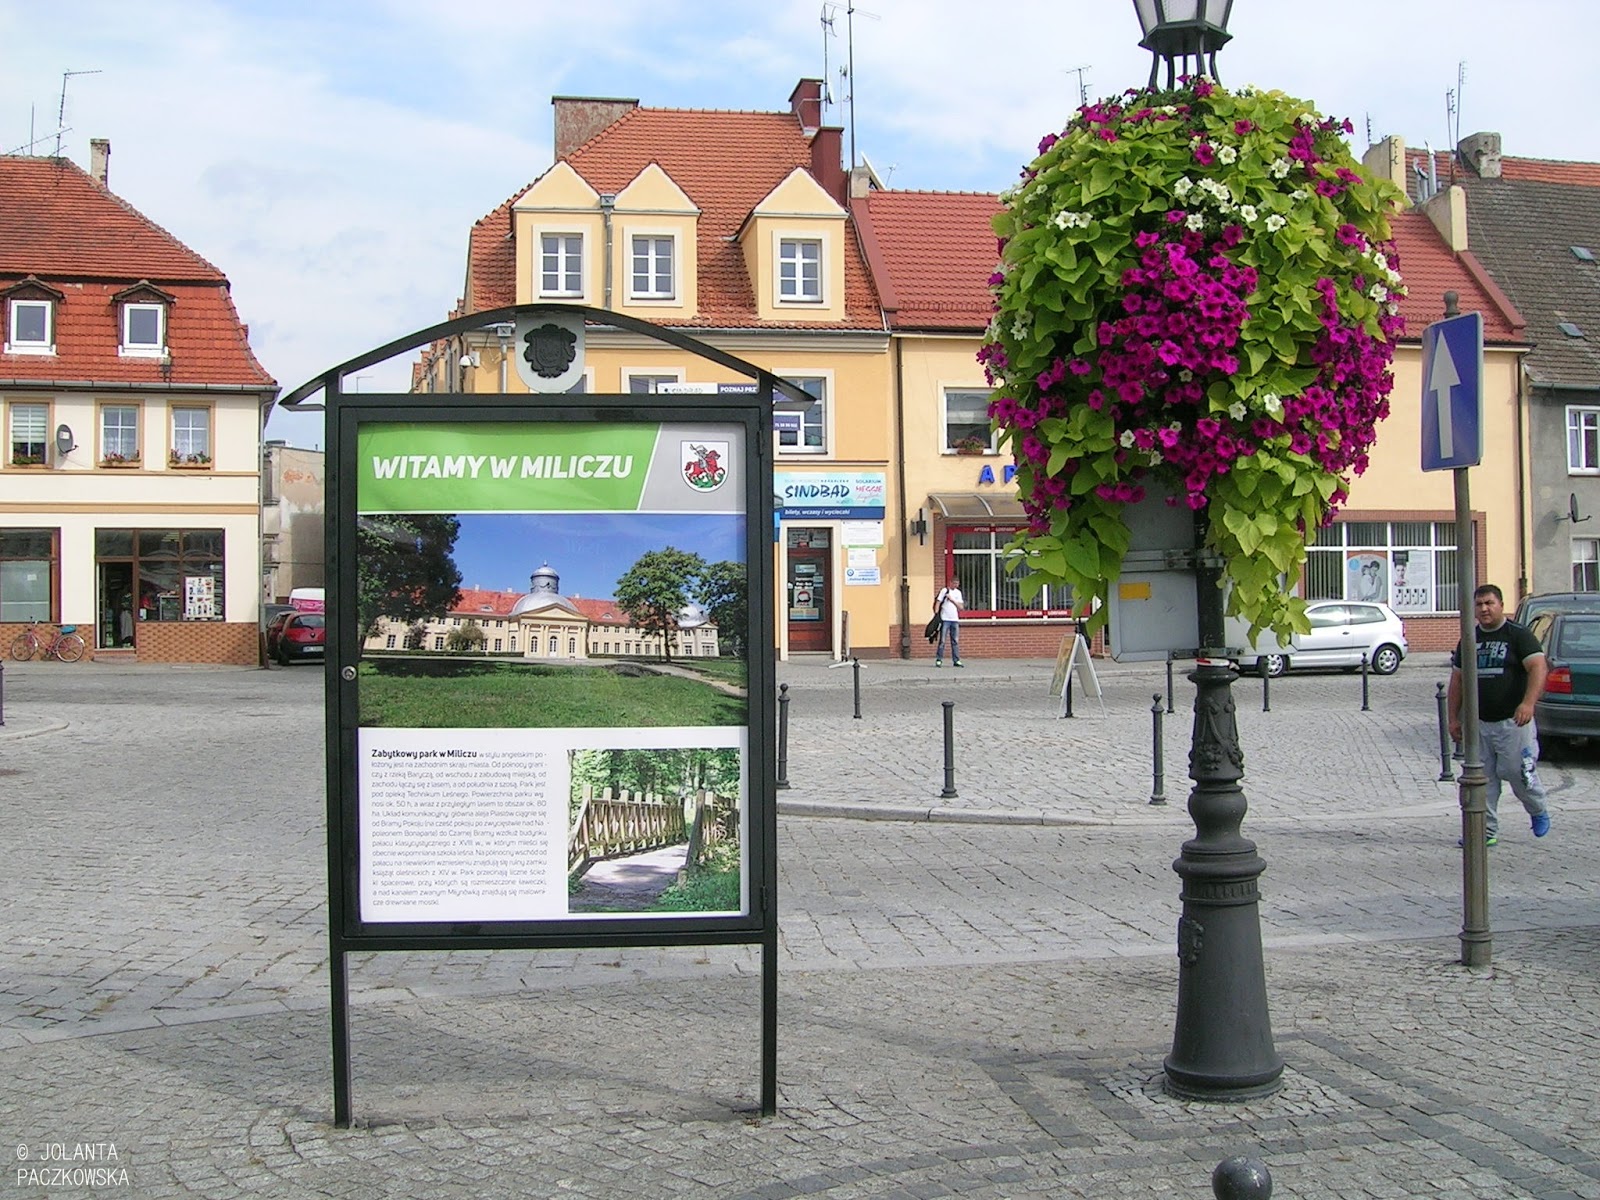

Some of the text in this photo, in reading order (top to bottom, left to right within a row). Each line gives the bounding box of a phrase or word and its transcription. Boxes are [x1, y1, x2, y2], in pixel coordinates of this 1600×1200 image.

[373, 456, 633, 479] WITAMY W MILICZU
[785, 484, 850, 499] SINDBAD
[372, 749, 417, 759] Zabytkowy
[420, 749, 437, 759] park
[447, 749, 477, 757] Miliczu
